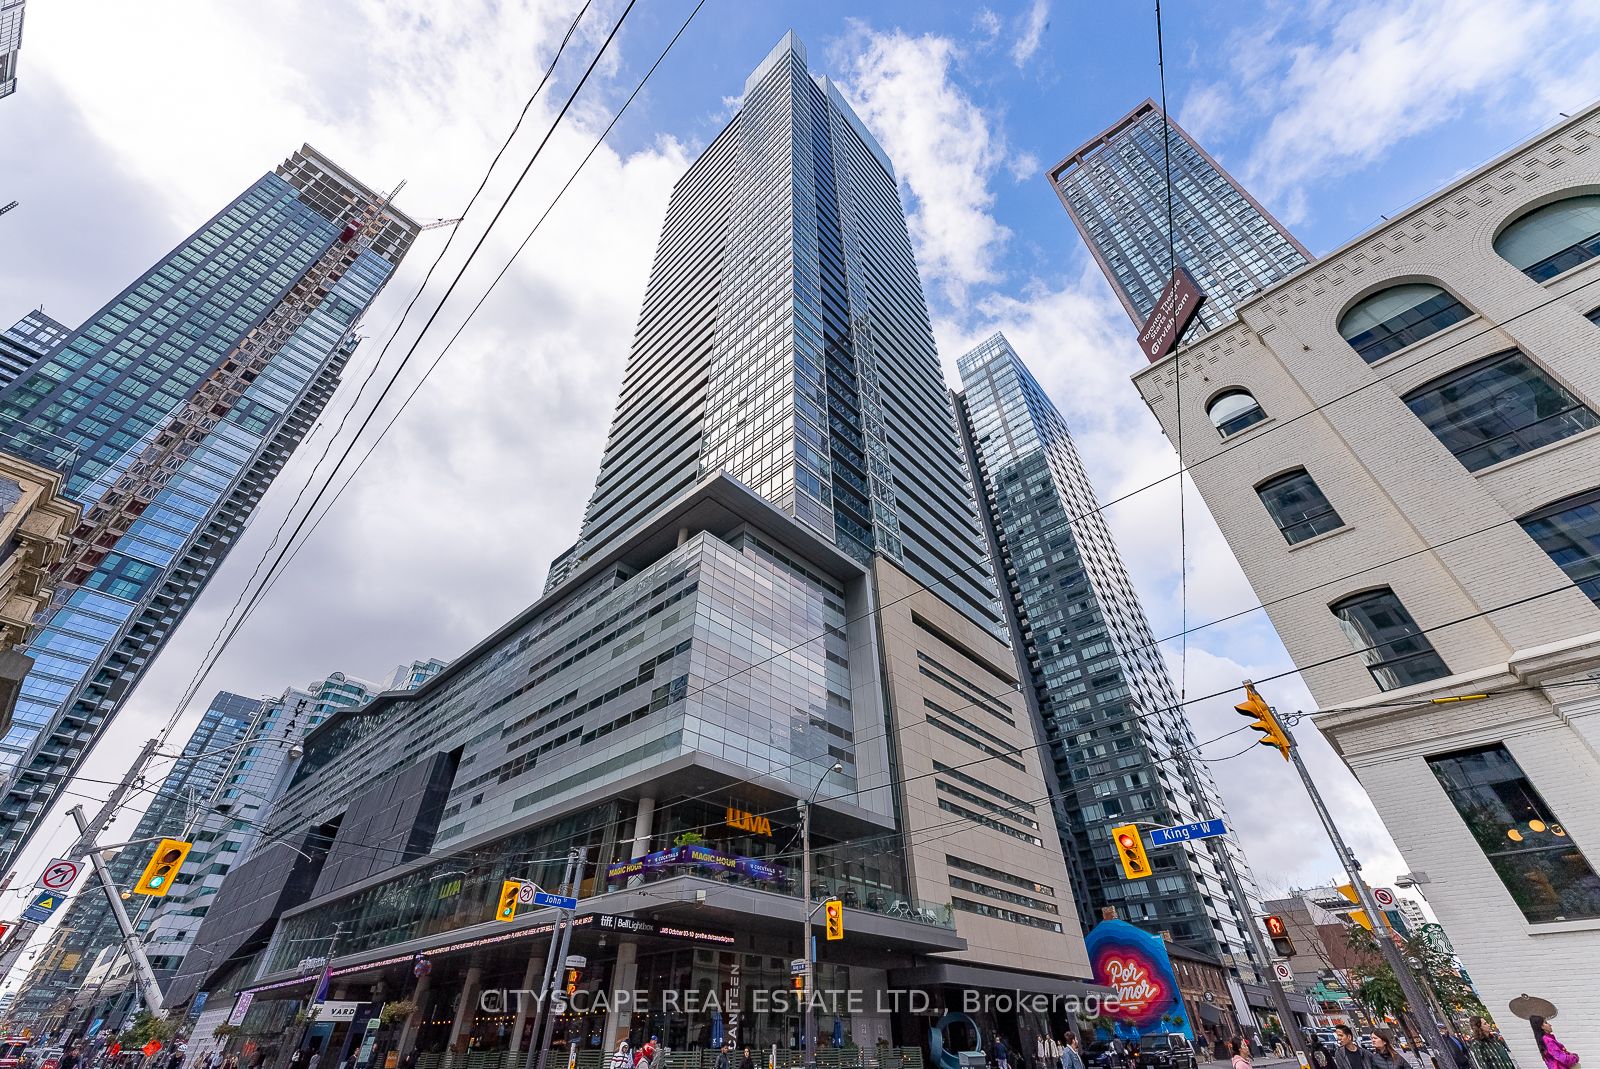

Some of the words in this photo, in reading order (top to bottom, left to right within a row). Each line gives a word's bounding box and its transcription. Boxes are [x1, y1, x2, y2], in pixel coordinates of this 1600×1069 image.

[1142, 313, 1162, 343] Toronto
[1151, 316, 1166, 339] Starts
[727, 807, 772, 837] LUMA
[1163, 828, 1190, 840] King
[1200, 822, 1211, 834] W
[608, 865, 626, 877] MAGIC
[626, 861, 643, 873] HOUR
[691, 851, 716, 863] MAGIC
[716, 857, 736, 868] HOUR
[545, 895, 562, 905] John
[601, 916, 612, 928] tiff.
[1106, 960, 1144, 983] Por
[728, 964, 740, 1050] CANTEEN
